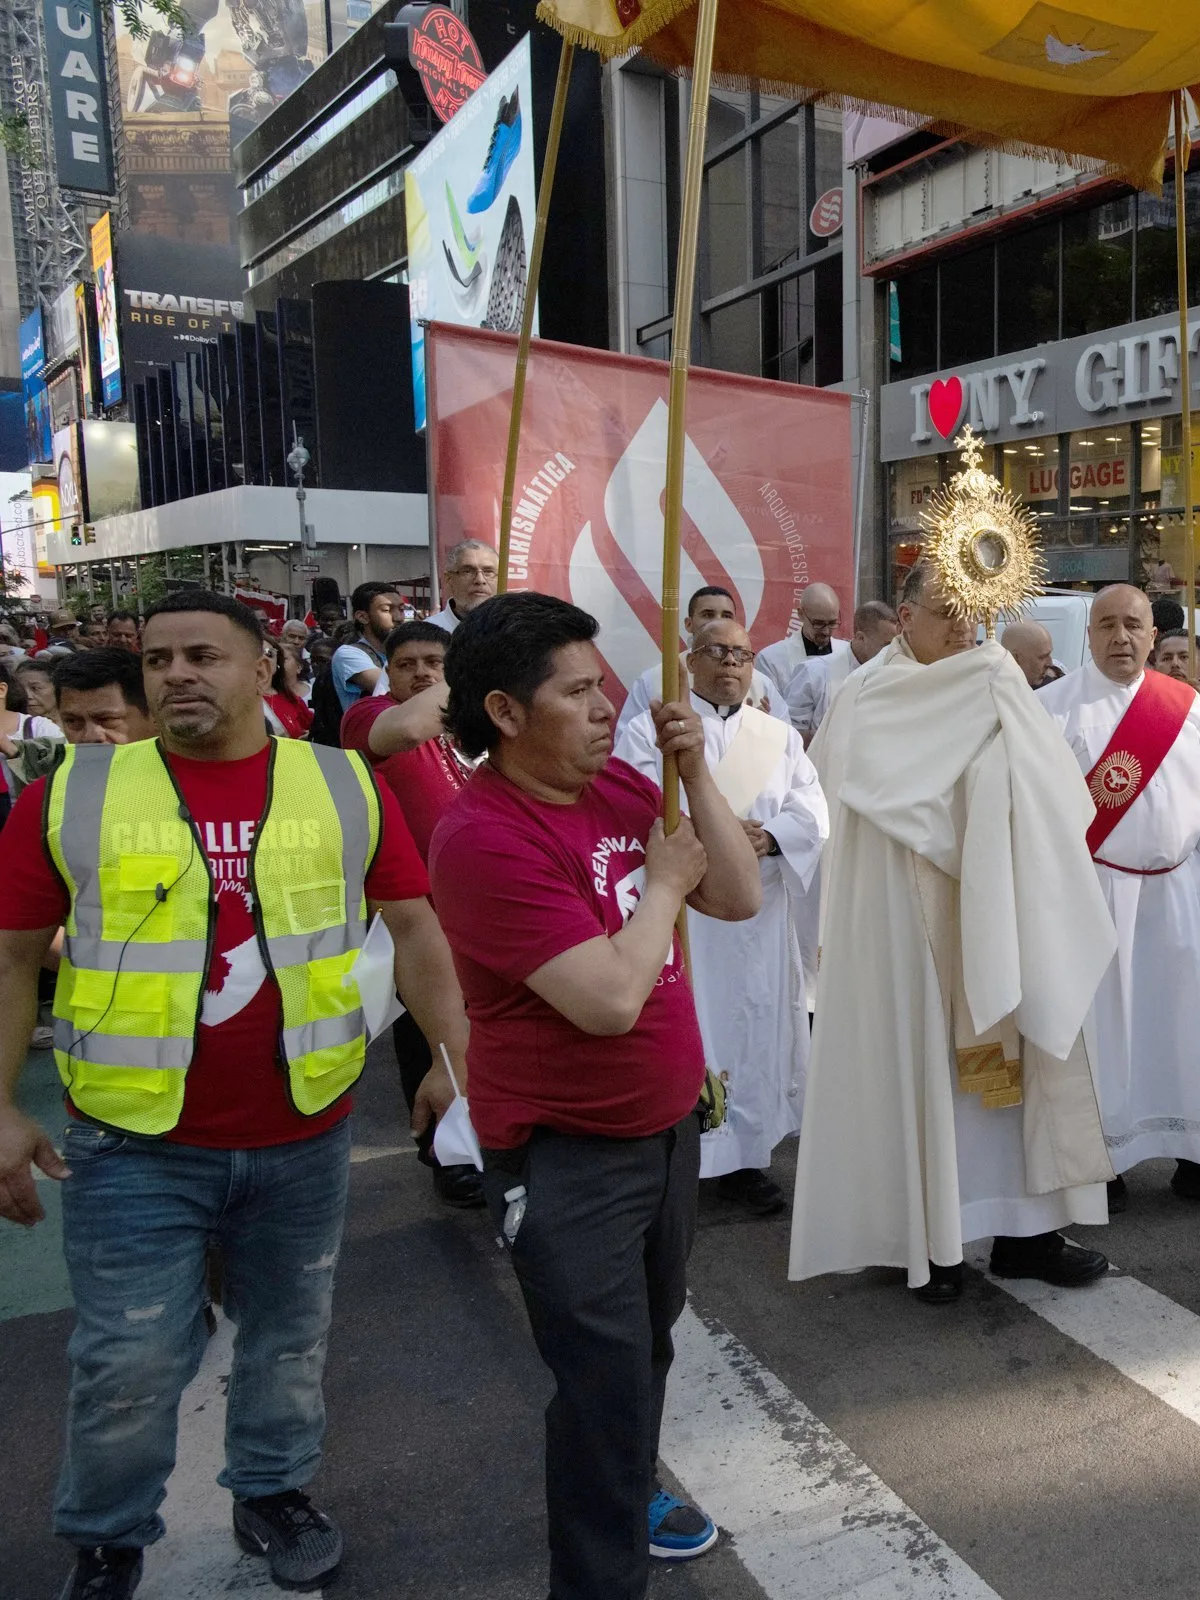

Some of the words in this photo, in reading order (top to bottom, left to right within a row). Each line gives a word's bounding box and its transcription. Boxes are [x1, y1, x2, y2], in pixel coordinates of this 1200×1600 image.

[434, 18, 469, 51] HOT
[416, 61, 457, 92] ORIGINAL
[131, 312, 176, 326] RISE
[188, 318, 211, 330] OF
[190, 335, 210, 344] Dolby
[910, 383, 933, 443] I
[964, 358, 1046, 433] NY
[508, 452, 576, 580] CARISMÁTICA
